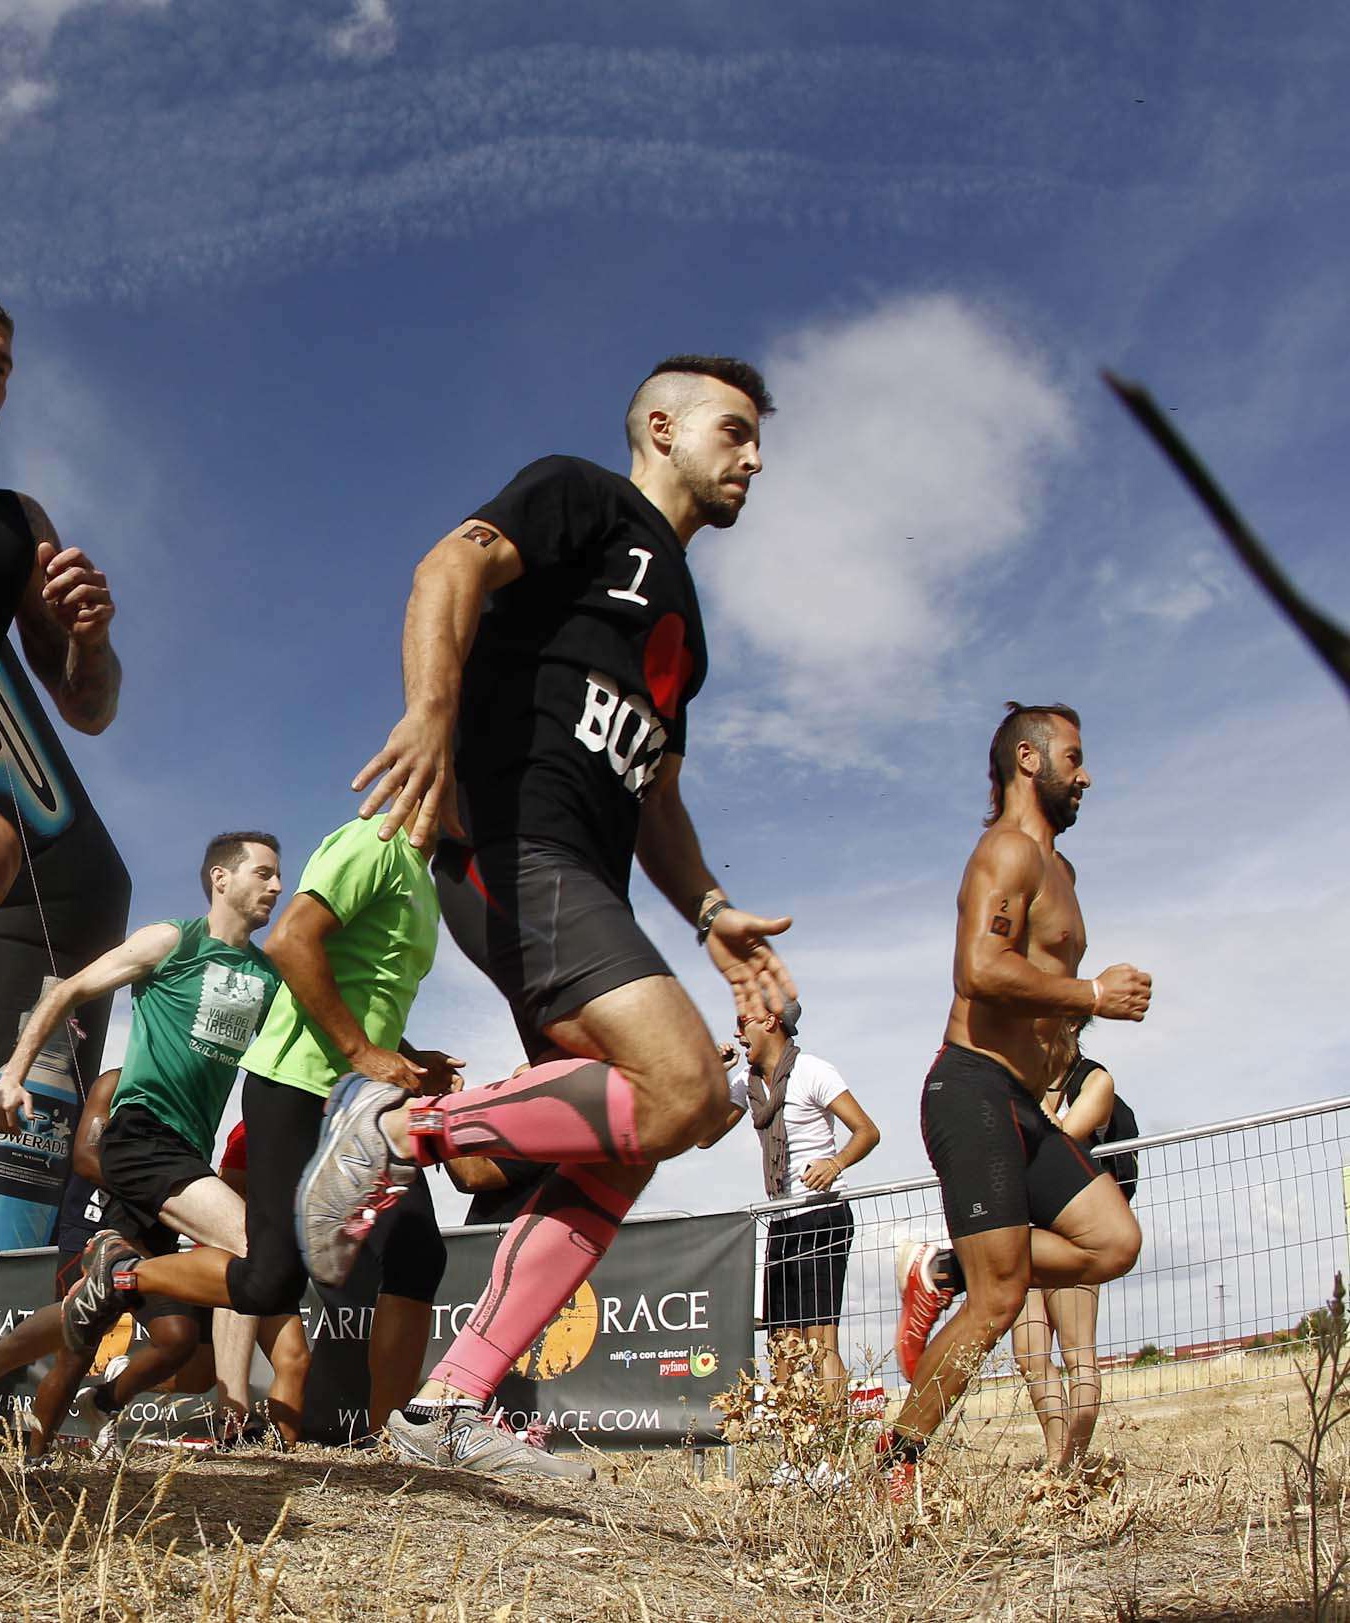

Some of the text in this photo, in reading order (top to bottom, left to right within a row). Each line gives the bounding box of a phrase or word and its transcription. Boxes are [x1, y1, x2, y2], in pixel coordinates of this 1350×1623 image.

[1000, 899, 1009, 913] 2
[209, 1007, 250, 1030] VALLE DEL
[204, 1018, 247, 1043] IREGUA
[599, 1291, 710, 1334] RACE
[639, 1350, 656, 1360] con
[657, 1349, 689, 1359] cáncer
[659, 1361, 689, 1376] pyfano
